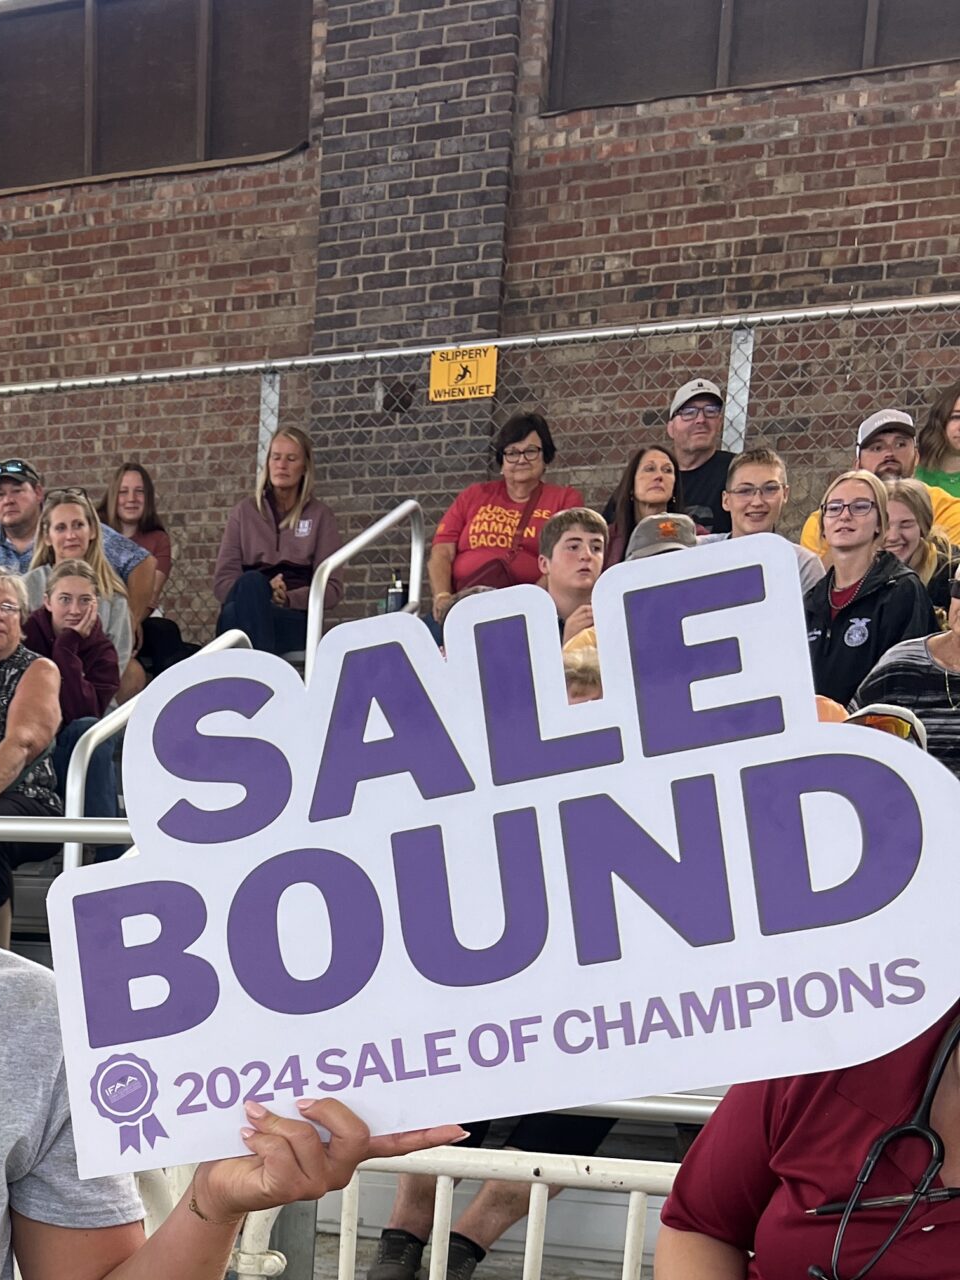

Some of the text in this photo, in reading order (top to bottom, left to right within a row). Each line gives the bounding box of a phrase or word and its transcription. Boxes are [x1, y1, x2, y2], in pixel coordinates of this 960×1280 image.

[433, 384, 492, 399] WHEN WET
[439, 348, 489, 361] SLIPPERY
[469, 521, 536, 538] HAMAN
[152, 563, 785, 845] SALE
[73, 752, 924, 1048] BOUND
[174, 957, 926, 1114] 2024 SALE OF CHAMPIONS
